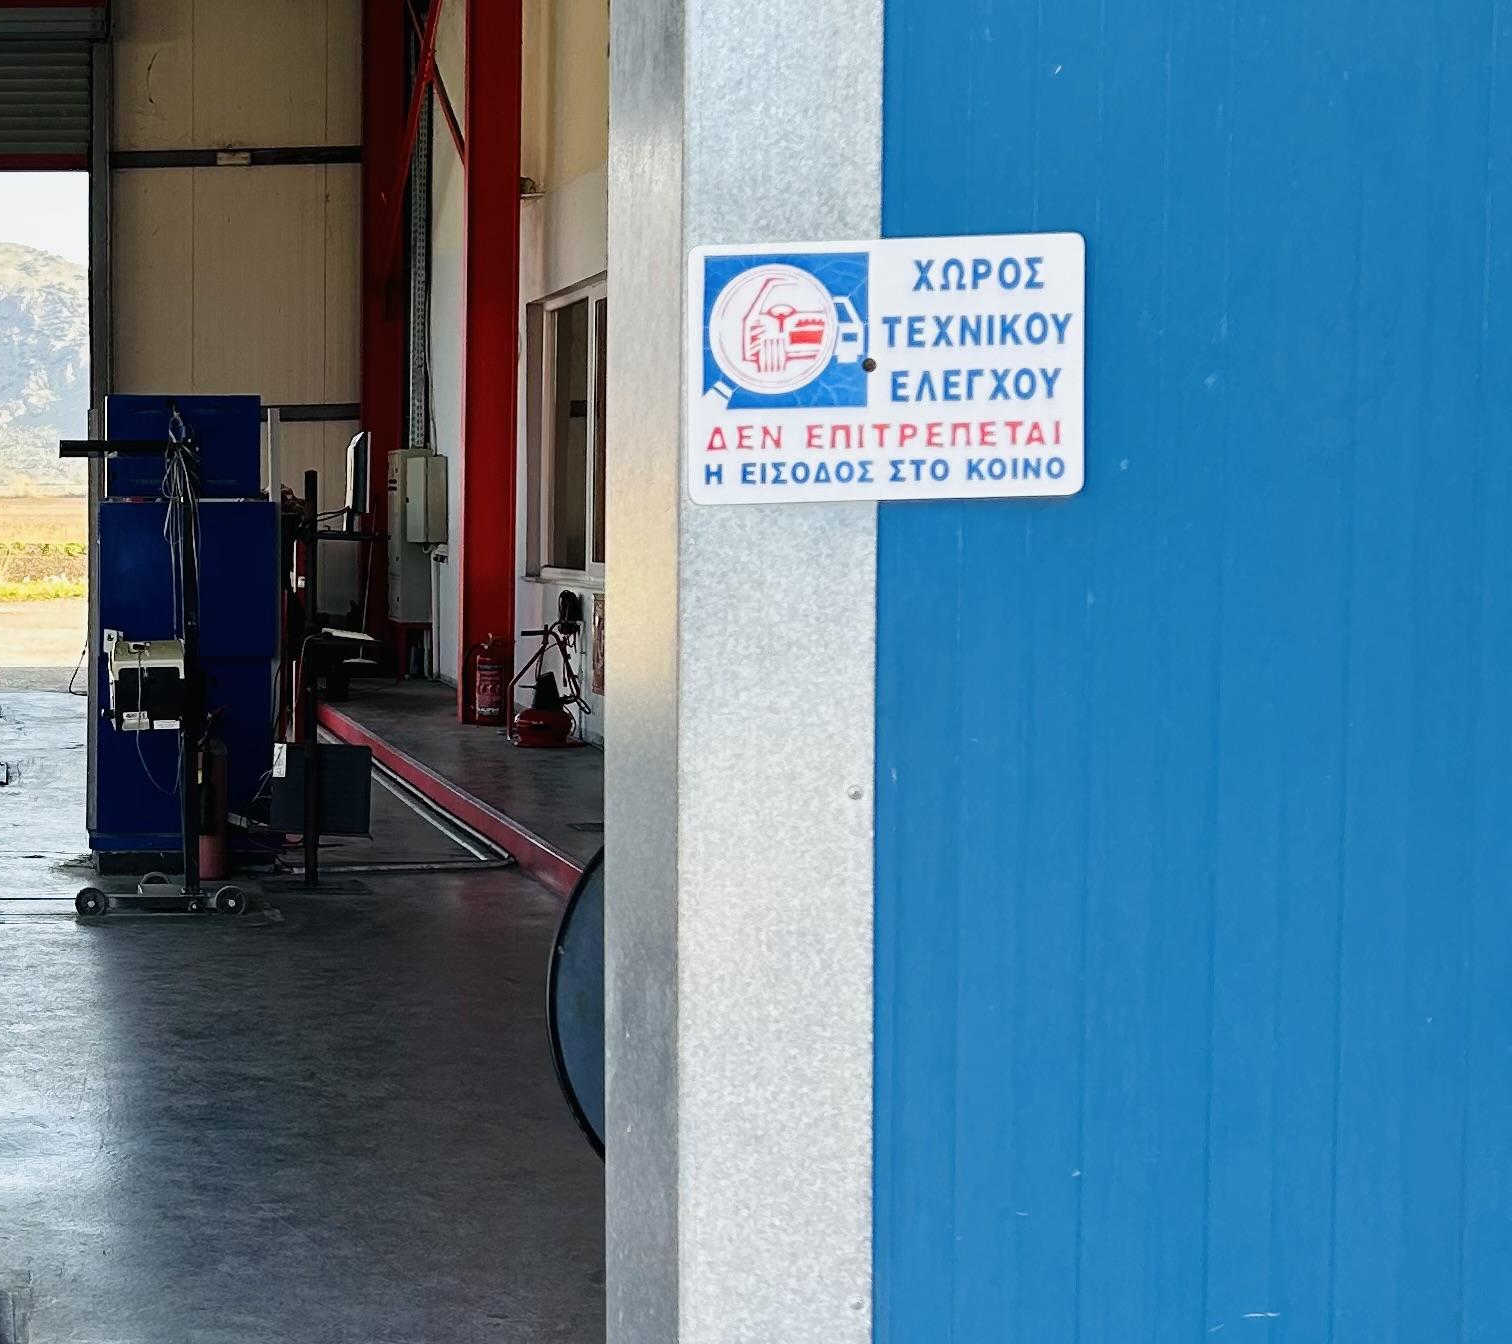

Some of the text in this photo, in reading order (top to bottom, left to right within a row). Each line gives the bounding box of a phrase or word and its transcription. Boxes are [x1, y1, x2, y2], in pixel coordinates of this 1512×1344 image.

[912, 256, 1045, 292] ΧΩΡΟΣ
[881, 312, 1073, 348] ΤΕΧΝΙΚΟΥ
[890, 367, 1062, 403] ΕΛΕΓΧΟΥ
[706, 420, 1062, 452] ΔΕΝ ΕΠΙΤΡΕΠΕΤΑΙ
[703, 456, 1067, 486] Η ΕΙΣΟΔΟΣ ΣΤΟ ΚΟΙΝΟ
